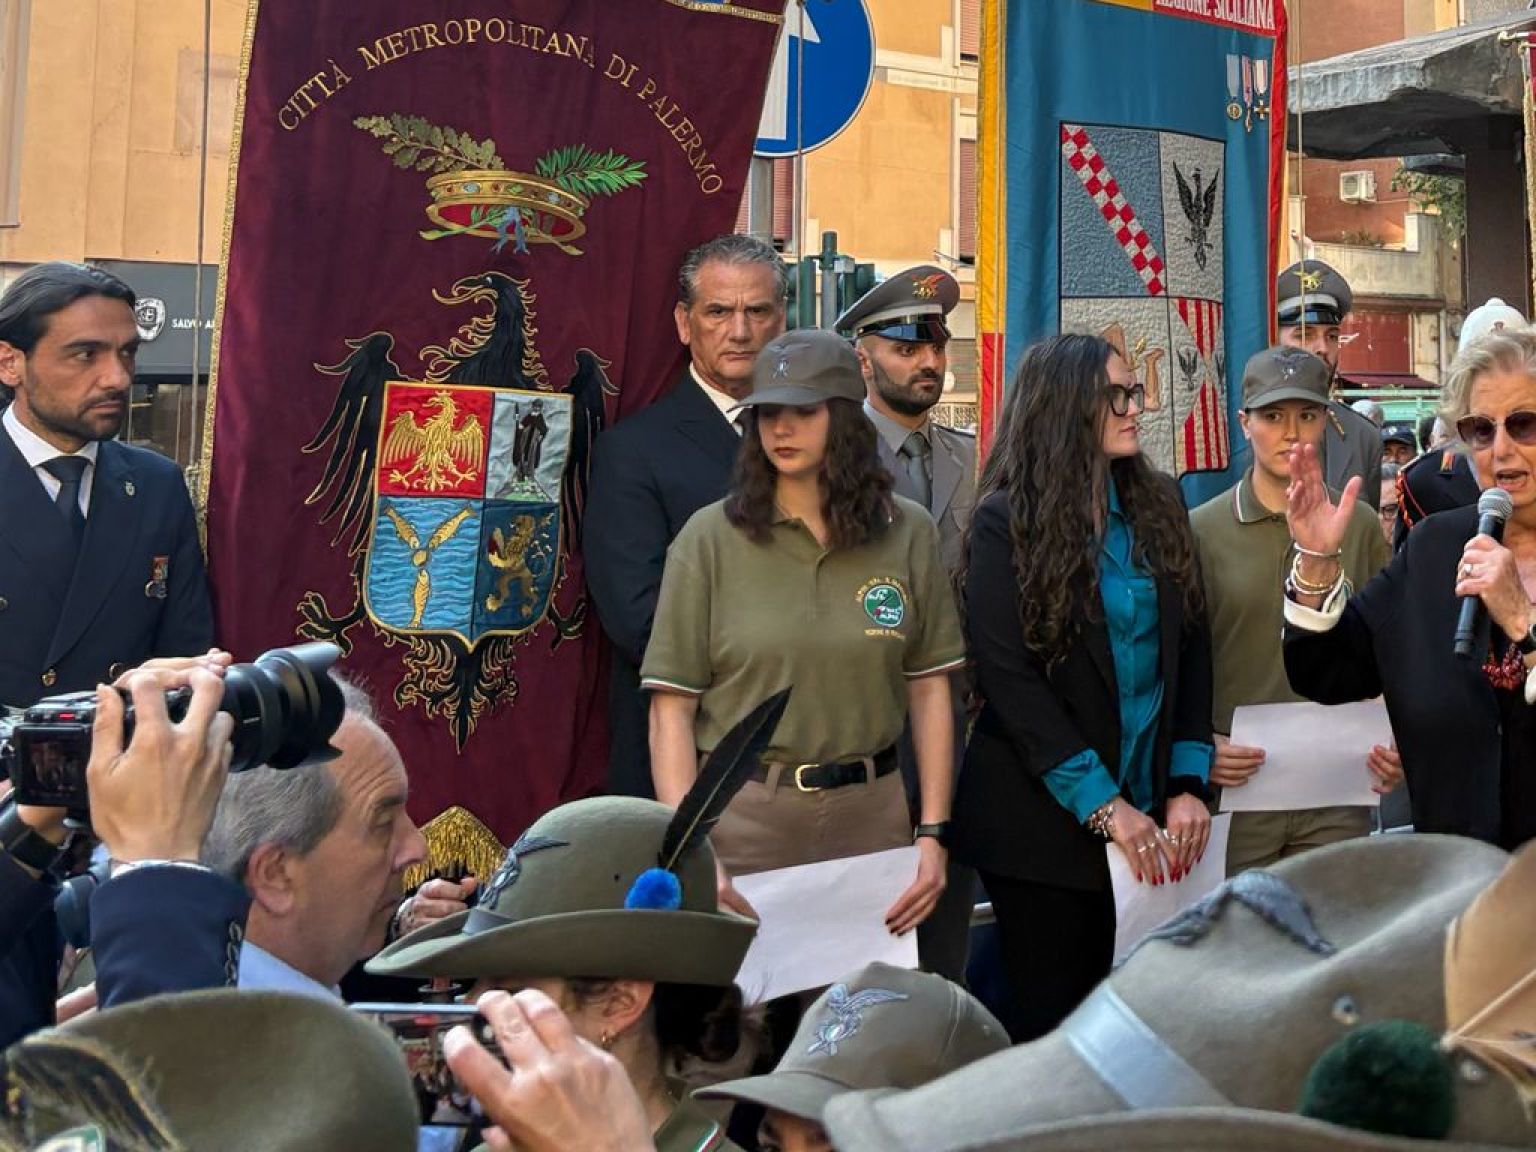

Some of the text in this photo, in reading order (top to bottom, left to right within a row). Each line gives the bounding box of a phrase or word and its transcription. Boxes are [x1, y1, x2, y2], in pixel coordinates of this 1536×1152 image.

[279, 17, 723, 194] CITTÀ METROPOLITANA DI PALERMO
